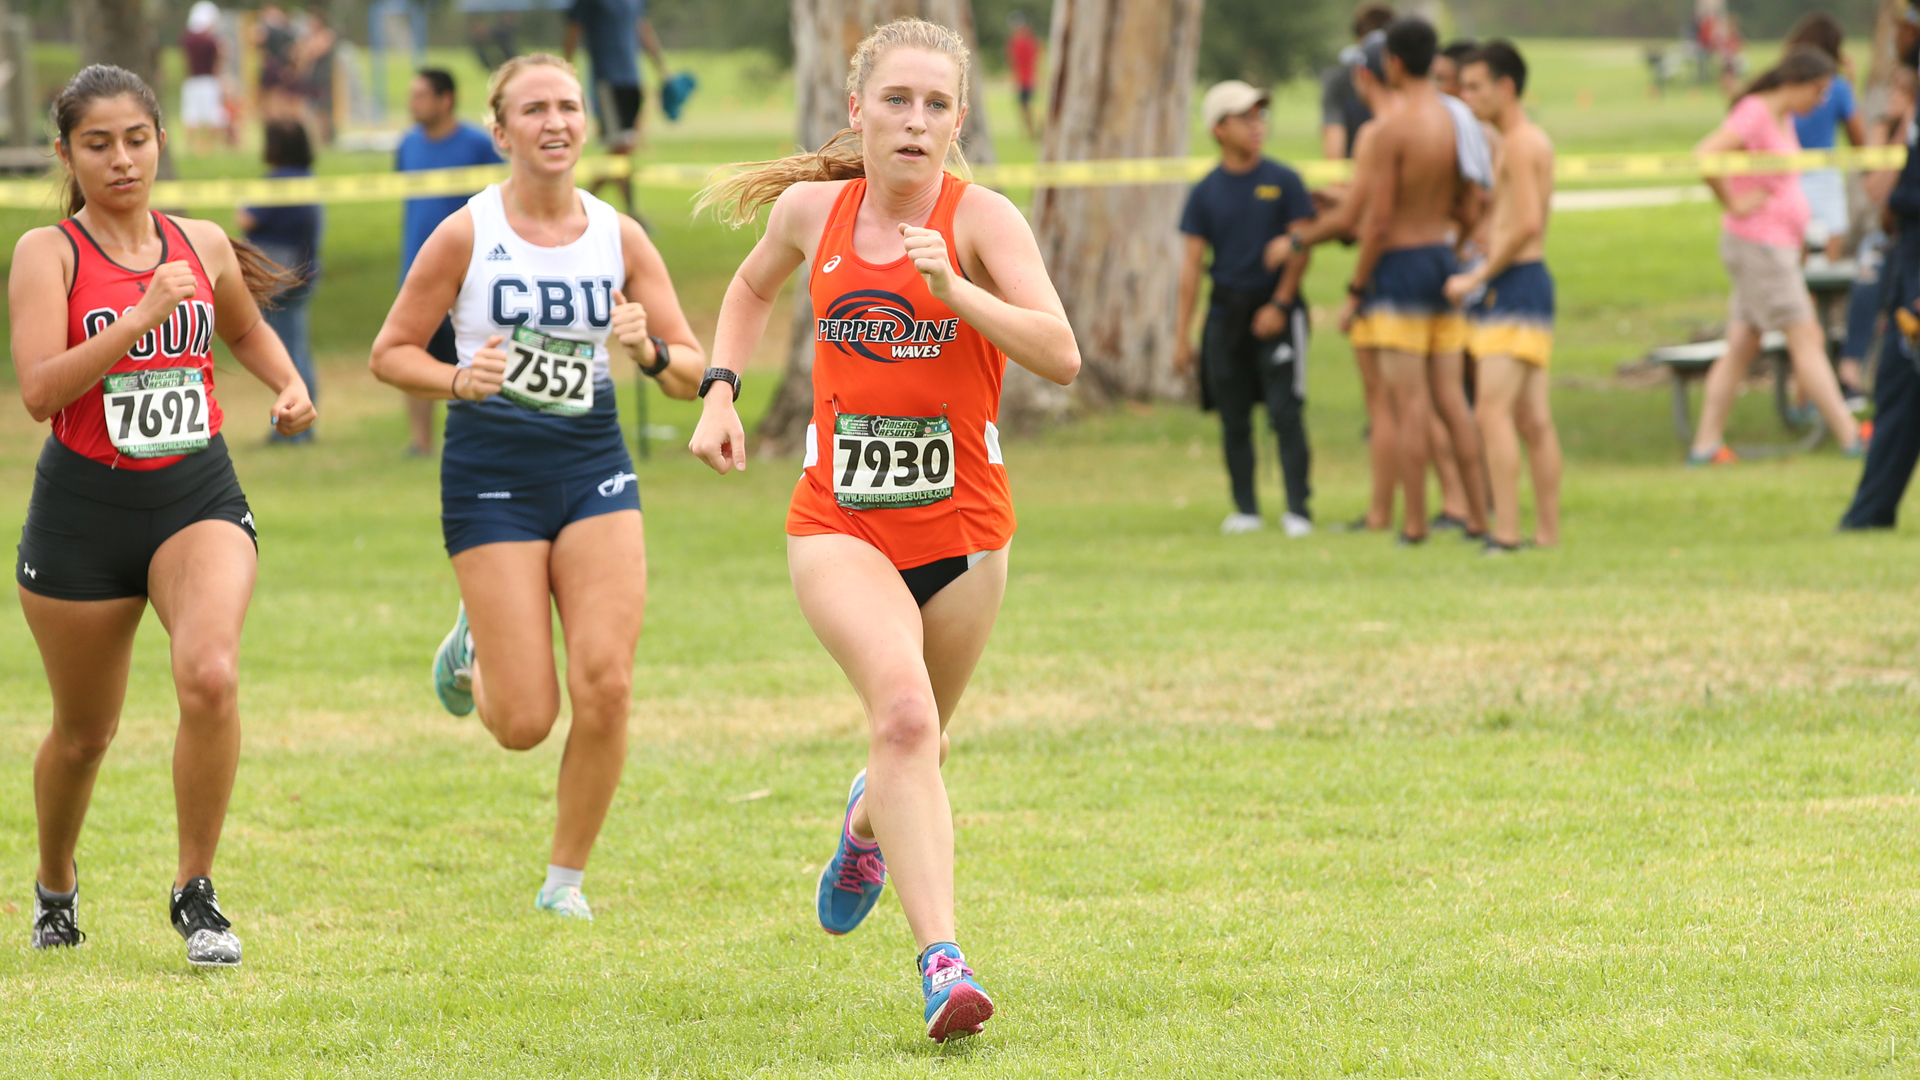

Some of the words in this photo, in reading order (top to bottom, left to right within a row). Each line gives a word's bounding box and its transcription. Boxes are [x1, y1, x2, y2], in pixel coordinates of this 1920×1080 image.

[489, 275, 614, 329] CBU
[817, 314, 959, 343] PEPPERDINE
[891, 344, 942, 359] WAVES
[507, 347, 587, 400] 7552
[111, 389, 205, 440] 7692
[881, 420, 918, 430] FINISHED
[877, 428, 916, 438] RESULTS
[839, 439, 950, 487] 7930
[837, 487, 952, 503] WWW.FINISHEDRESULTS.COM
